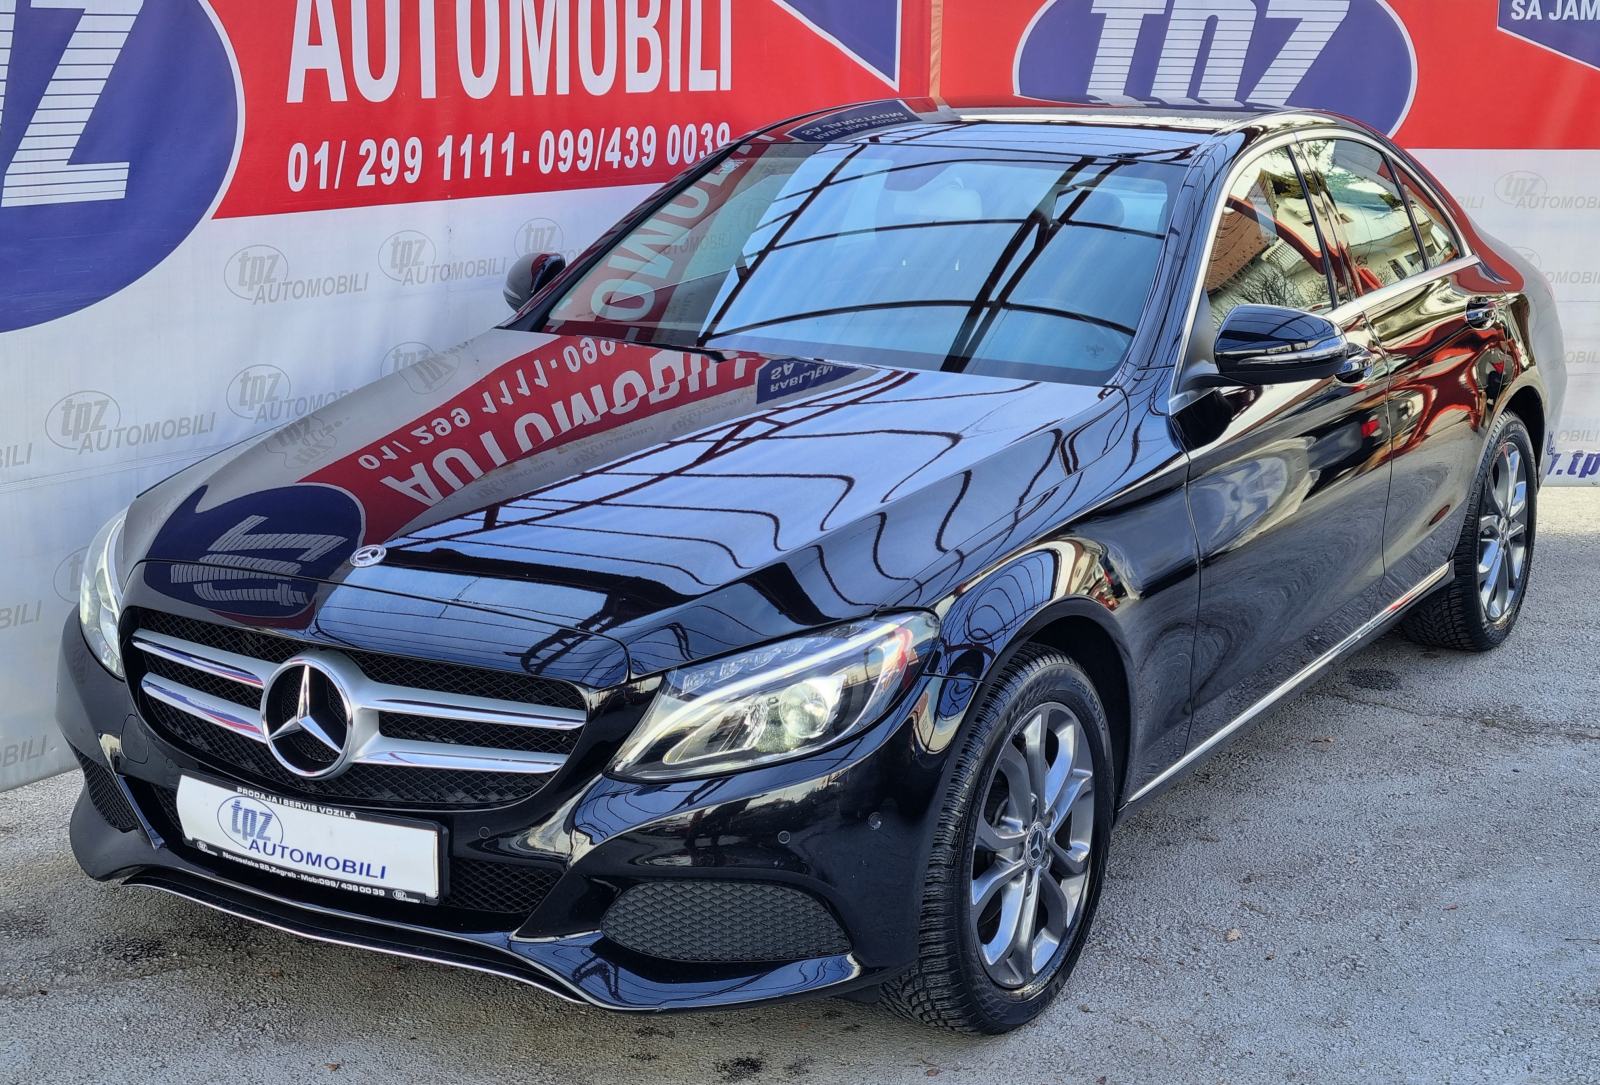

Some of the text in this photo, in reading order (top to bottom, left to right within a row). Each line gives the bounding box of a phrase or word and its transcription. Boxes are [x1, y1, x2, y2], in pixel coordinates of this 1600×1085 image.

[1511, 0, 1542, 20] SA
[286, 0, 733, 103] AUTOMOBILI
[287, 140, 346, 192] 01/
[356, 136, 423, 187] 299
[1515, 195, 1600, 209] AUTOMOB
[238, 251, 280, 292] tpz
[253, 272, 369, 305] AUTOMOBILI
[402, 257, 508, 286] AUTOMOBILI
[62, 399, 110, 441] tpz
[78, 412, 216, 455] AUTOMOBILI
[0, 734, 48, 768] BILI
[231, 799, 273, 841] tpz
[236, 786, 278, 804] PRODAJA
[283, 799, 318, 812] SERVIS
[318, 807, 357, 819] VOZILA
[248, 838, 387, 880] AUTOMOBILI
